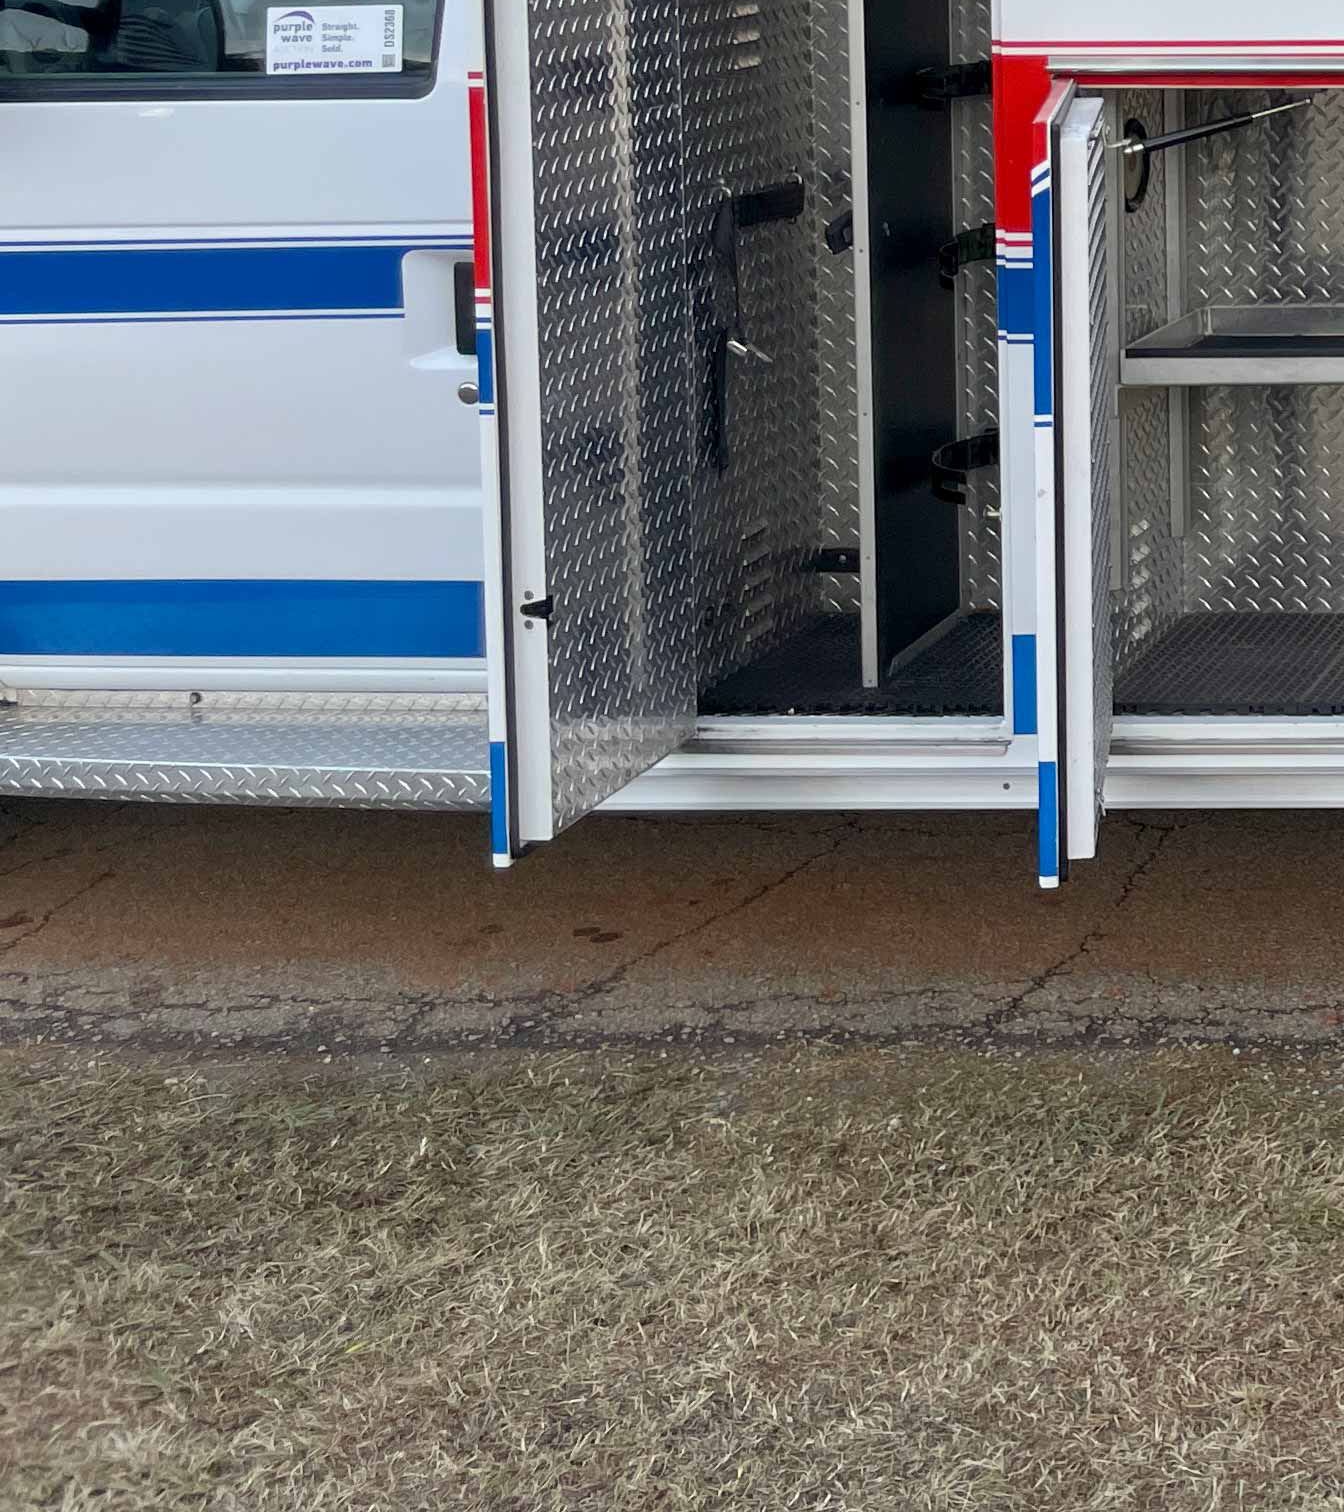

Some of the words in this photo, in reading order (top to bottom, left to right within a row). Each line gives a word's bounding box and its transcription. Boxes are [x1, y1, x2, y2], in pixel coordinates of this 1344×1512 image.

[273, 22, 313, 34] purple
[321, 23, 360, 33] Straight.
[281, 34, 313, 43] wave
[321, 34, 354, 43] Simple.
[321, 44, 344, 53] Sold.
[273, 58, 373, 72] purplewave.com
